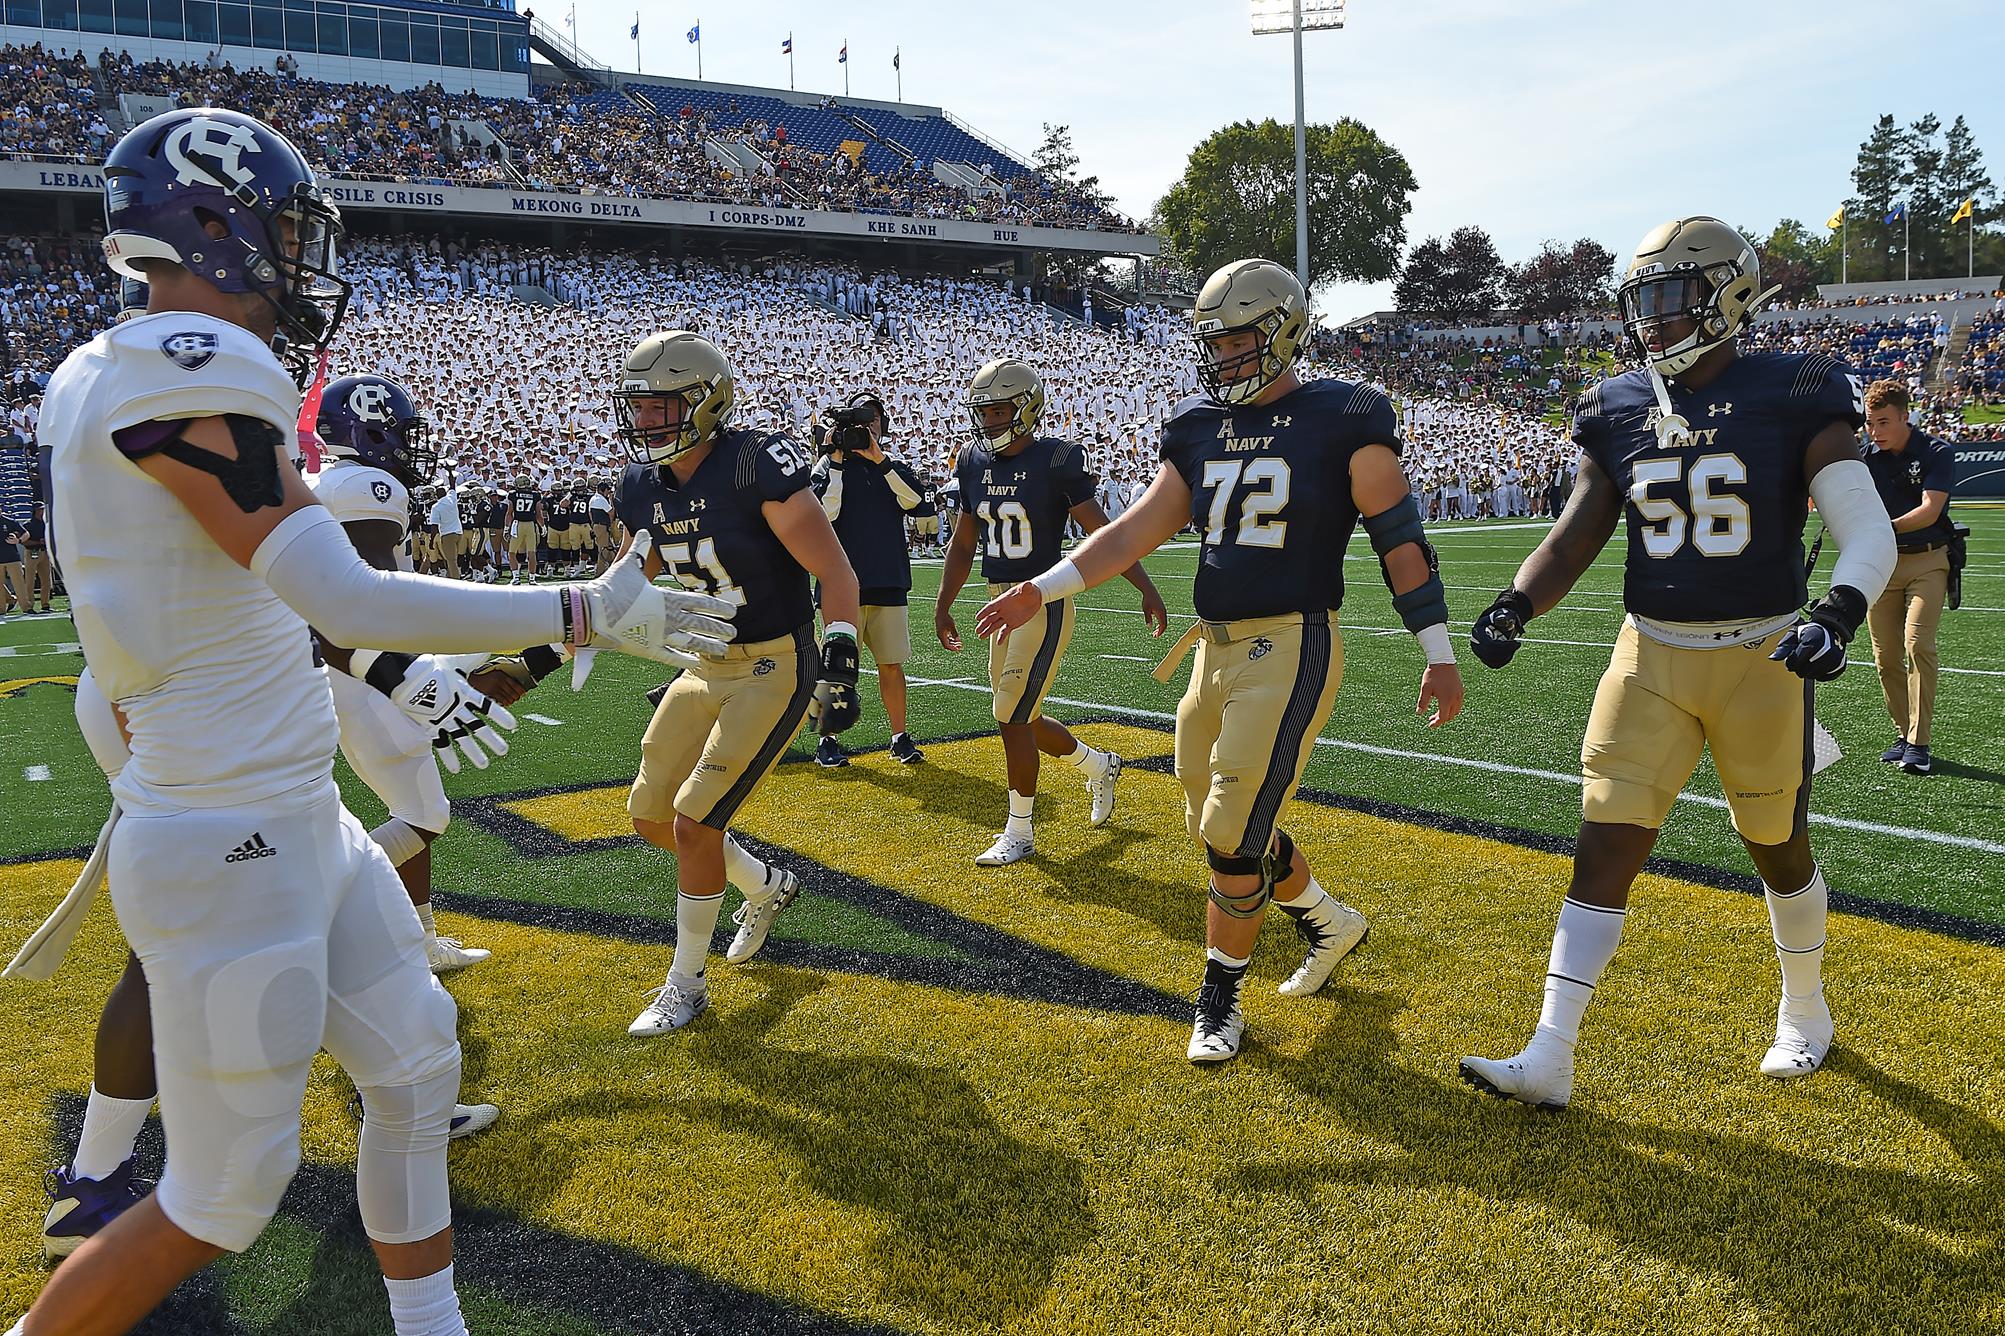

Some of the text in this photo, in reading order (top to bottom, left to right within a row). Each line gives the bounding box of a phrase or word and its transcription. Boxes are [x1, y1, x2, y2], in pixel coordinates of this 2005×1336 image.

[383, 190, 444, 206] CRISIS
[512, 198, 642, 217] MEKONG DELTA
[721, 211, 806, 228] CORPS-DMZ
[868, 221, 937, 236] KHE SANH
[993, 230, 1018, 242] HUE
[1224, 436, 1275, 452] NAVY
[986, 485, 1018, 496] NAVY
[516, 499, 533, 512] 87
[572, 501, 587, 514] 79
[1202, 457, 1292, 549] 72
[1631, 452, 1752, 559] 56
[661, 518, 700, 535] NAVY
[976, 500, 1033, 559] 10
[659, 537, 748, 607] 51
[845, 657, 855, 669] N
[225, 847, 277, 864] adidas
